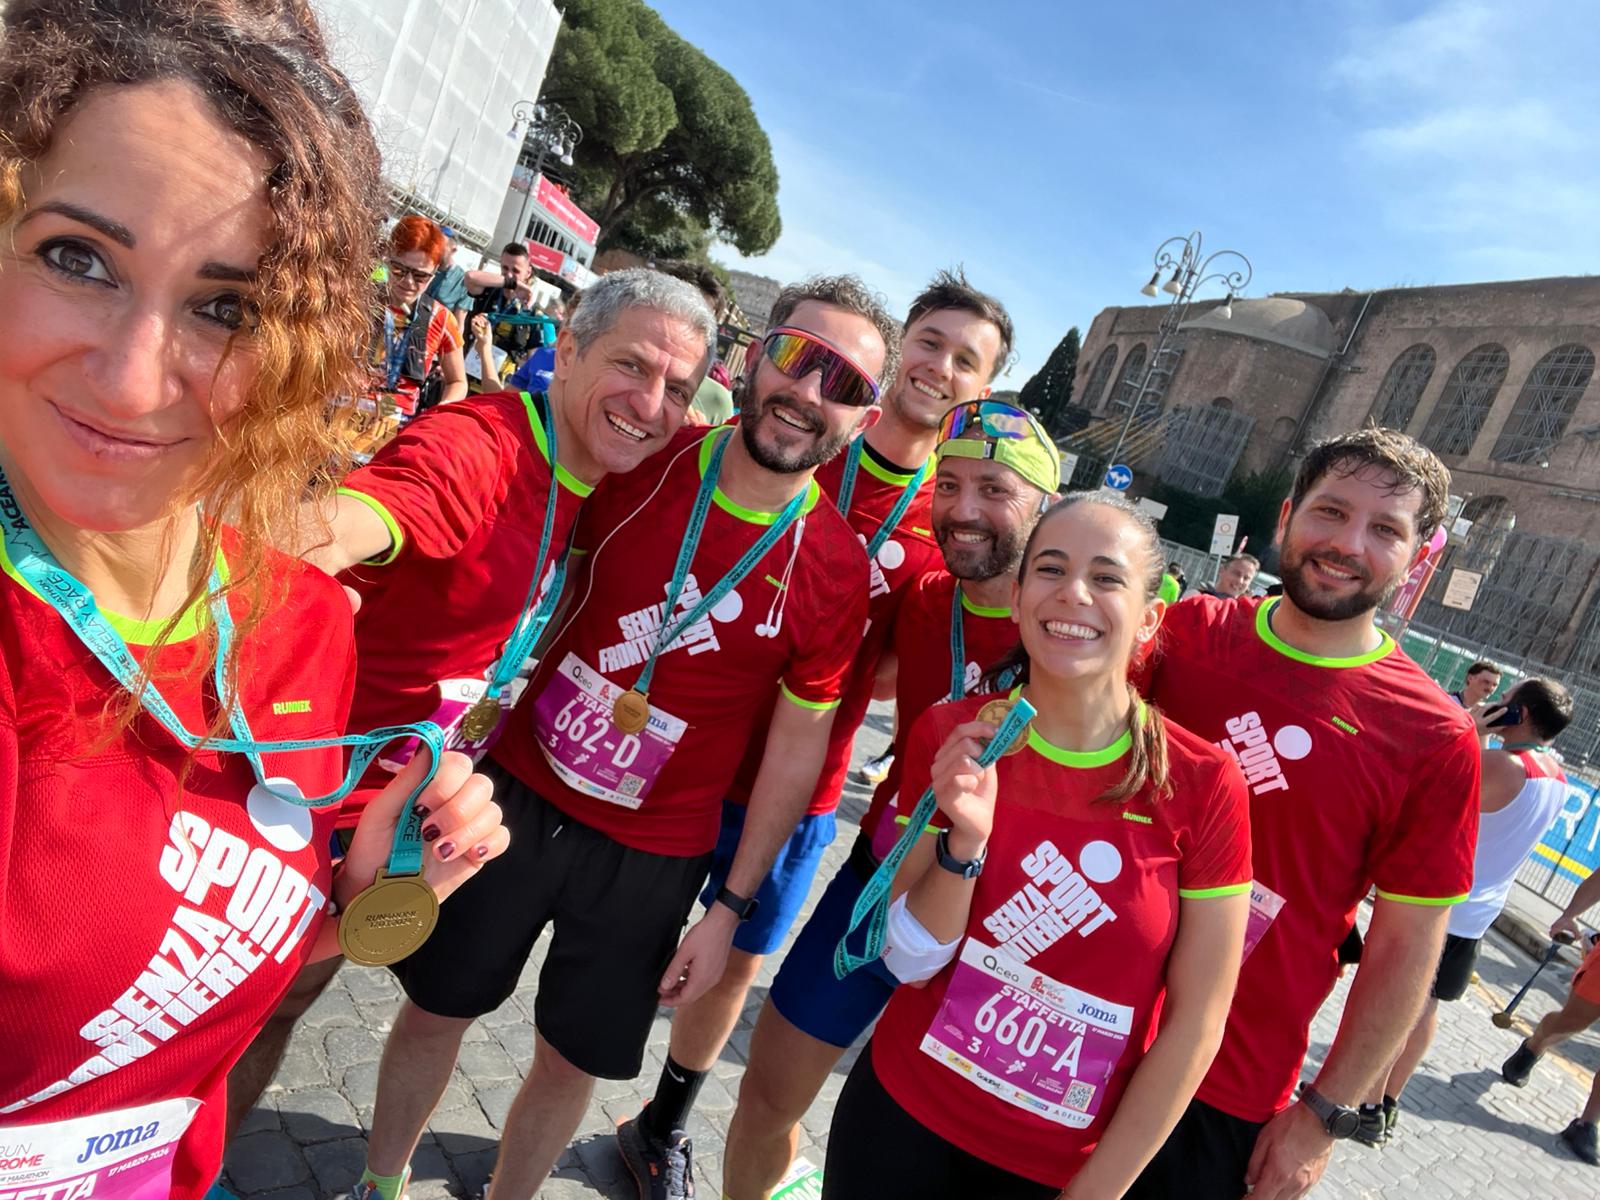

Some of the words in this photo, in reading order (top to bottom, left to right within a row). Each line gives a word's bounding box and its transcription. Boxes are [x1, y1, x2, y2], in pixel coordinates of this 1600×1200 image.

[36, 579, 79, 619] MARATHON
[46, 572, 89, 610] RACE
[81, 610, 121, 655] RELAY
[576, 691, 614, 722] STAFF
[548, 734, 559, 748] 3
[554, 699, 641, 769] 662-D
[1225, 711, 1289, 796] SPORT
[158, 810, 326, 964] SPORT
[1020, 840, 1118, 938] SPORT
[982, 882, 1052, 943] SENZA
[79, 905, 231, 1048] SENZA
[974, 992, 1085, 1078] 660-A
[1000, 984, 1087, 1037] STAFFETTA
[967, 1036, 983, 1054] 3
[0, 1153, 46, 1170] ROME
[108, 1166, 120, 1178] 17
[119, 1154, 149, 1171] MARZO
[147, 1147, 170, 1161] 2024
